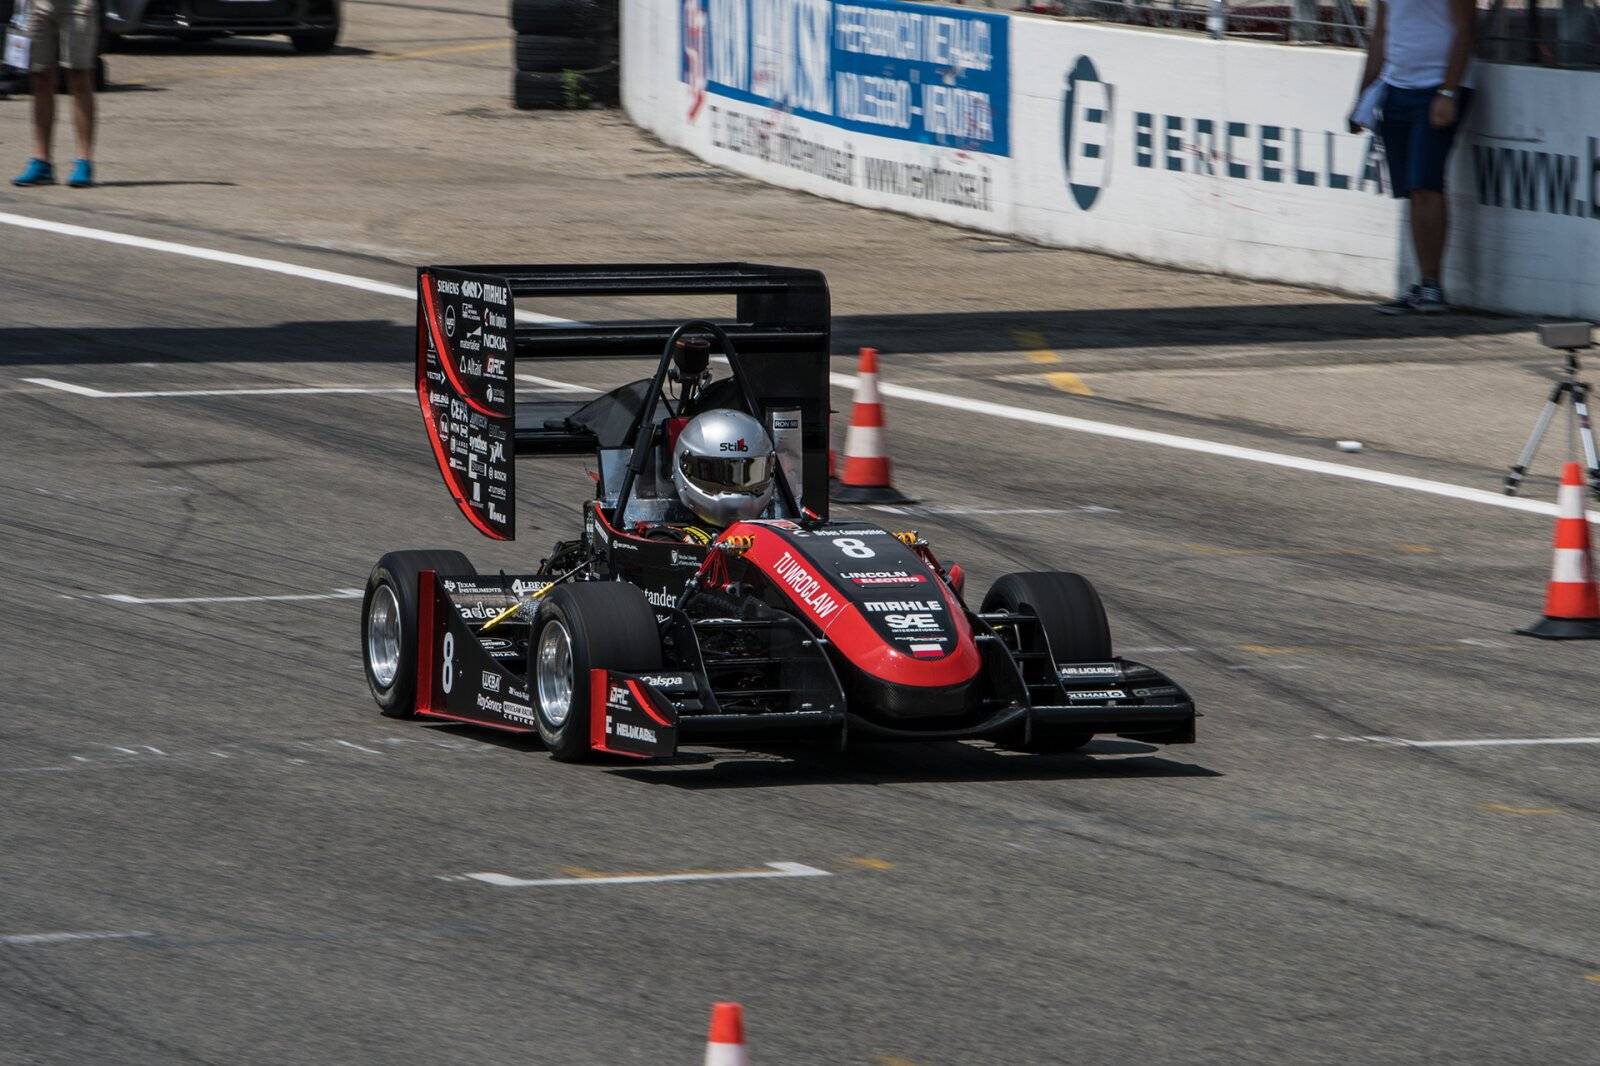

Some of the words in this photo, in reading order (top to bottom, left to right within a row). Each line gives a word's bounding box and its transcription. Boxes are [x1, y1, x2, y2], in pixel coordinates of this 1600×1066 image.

[437, 280, 459, 295] SIEMENS
[483, 283, 507, 306] MAHLE
[483, 333, 507, 351] NOKIA
[832, 538, 876, 558] 8
[840, 571, 908, 579] LINCOLN
[641, 586, 677, 608] tander
[864, 601, 943, 612] MAHLE
[884, 613, 940, 629] SAE
[442, 631, 454, 694] 8
[1079, 666, 1115, 674] LIQUIDE
